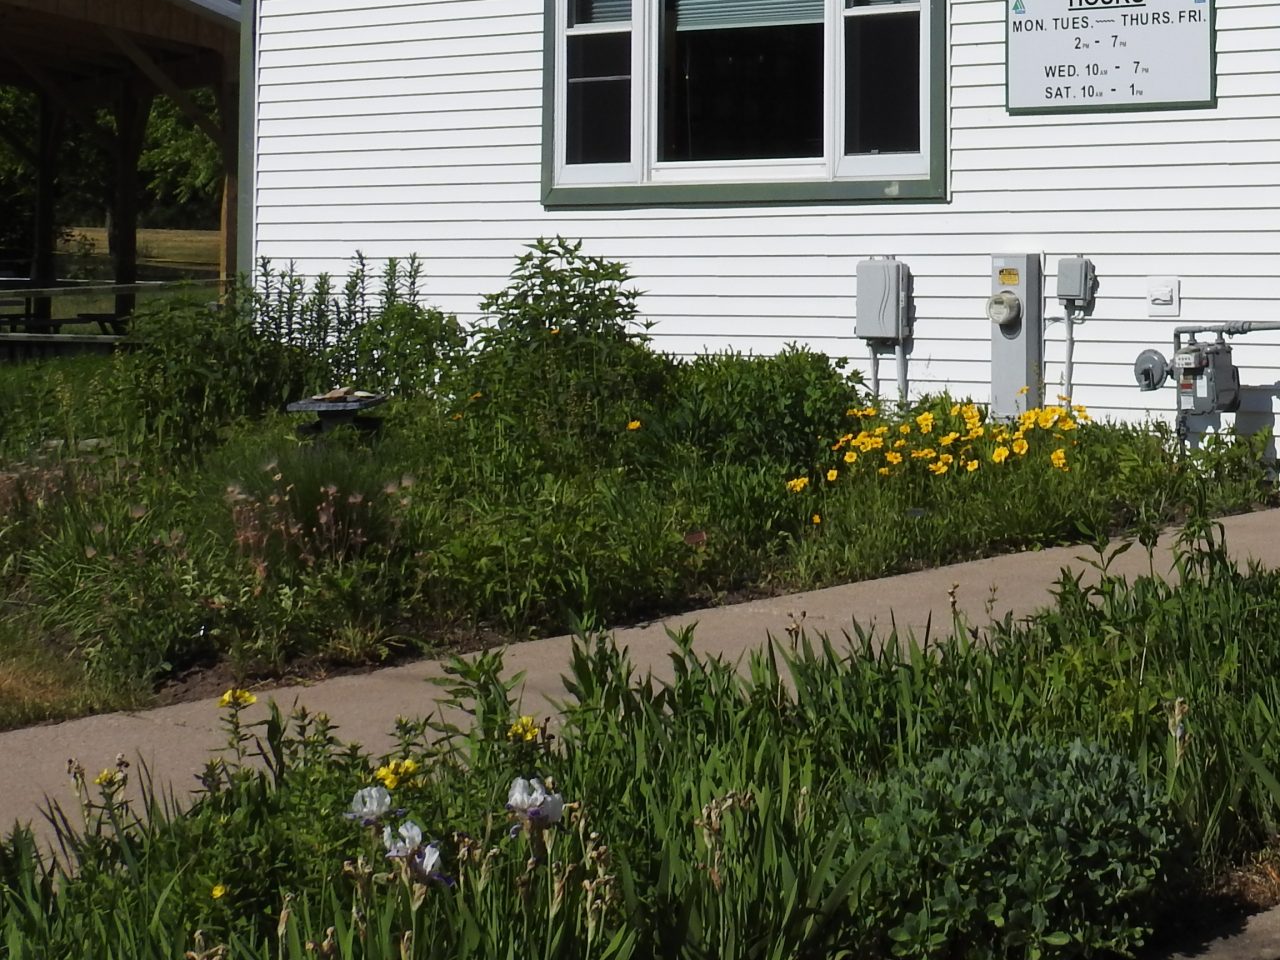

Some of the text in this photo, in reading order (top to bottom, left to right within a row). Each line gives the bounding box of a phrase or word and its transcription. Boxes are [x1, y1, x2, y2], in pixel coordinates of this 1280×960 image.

[1012, 10, 1207, 33] MON. TUES. THURS. FRI.
[1044, 64, 1080, 78] WED.
[1045, 86, 1076, 99] SAT.
